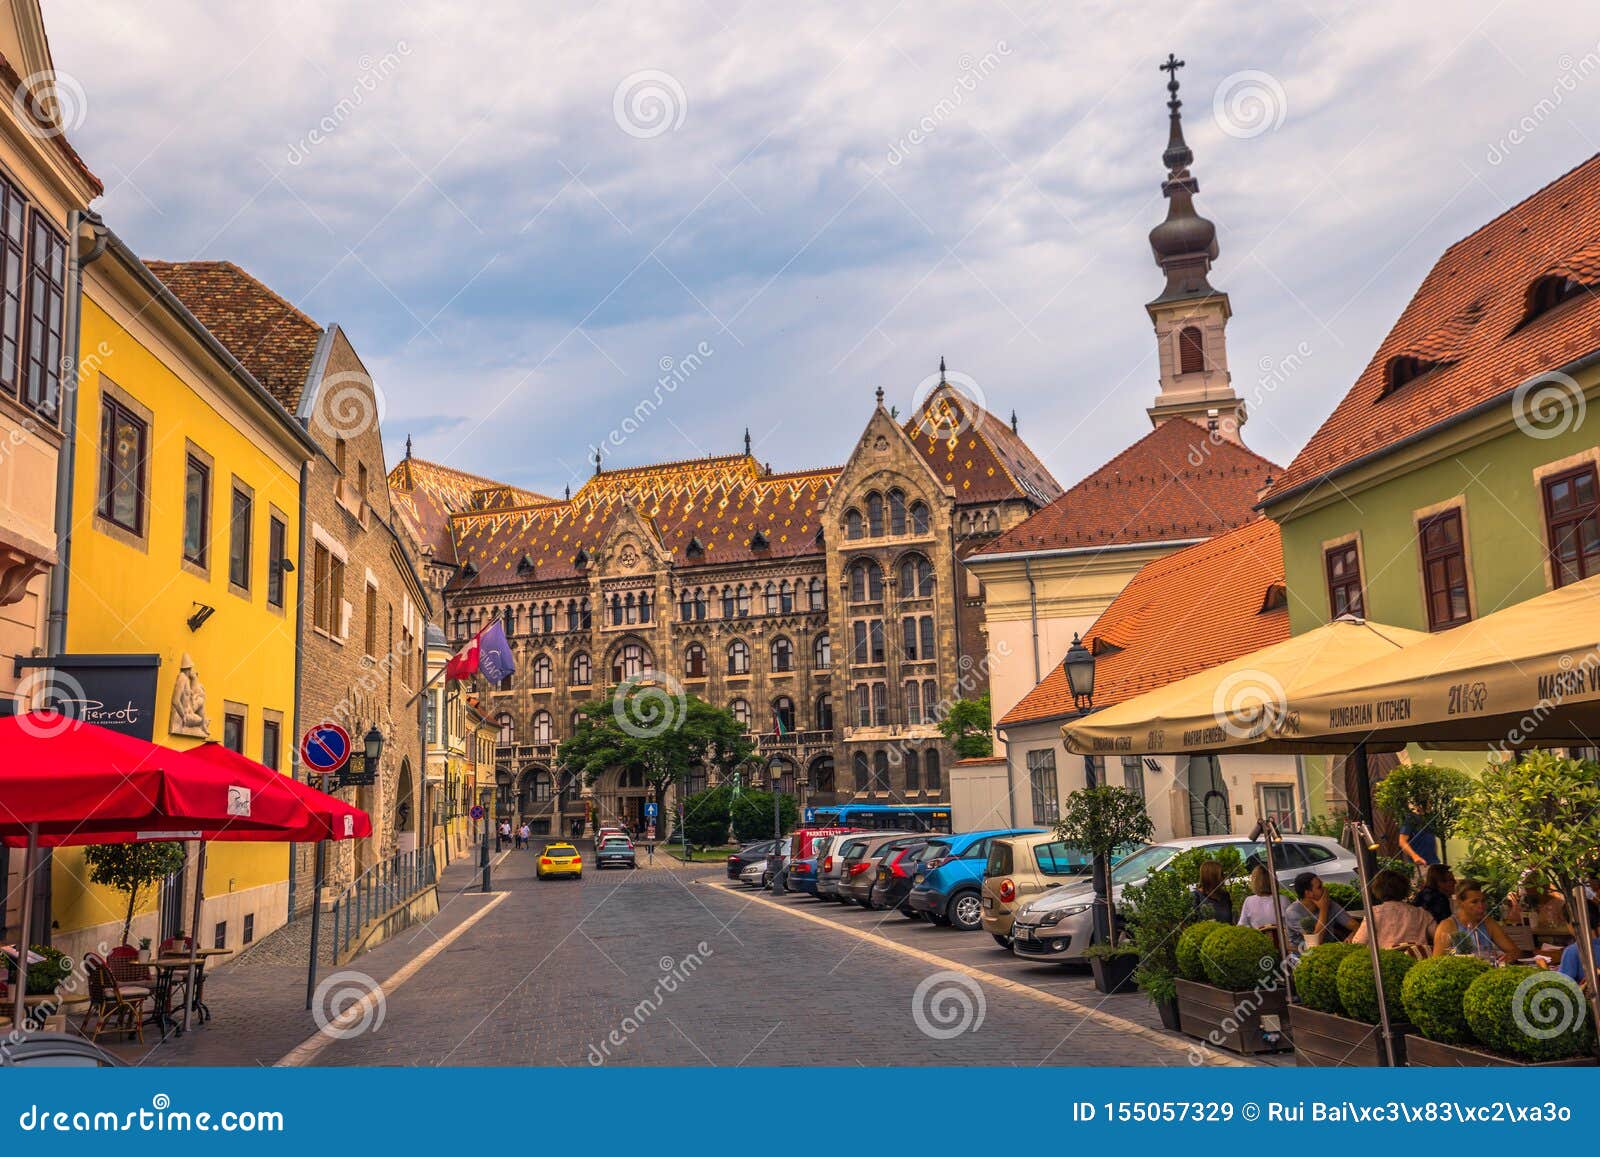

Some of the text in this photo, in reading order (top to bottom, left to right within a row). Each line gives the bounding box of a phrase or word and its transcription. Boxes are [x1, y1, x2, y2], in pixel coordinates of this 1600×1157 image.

[1589, 665, 1600, 692] V
[58, 699, 139, 723] Pierrot
[1448, 684, 1462, 714] 21
[1329, 703, 1373, 729] HUNGARIAN
[1376, 698, 1411, 723] KITCHEN
